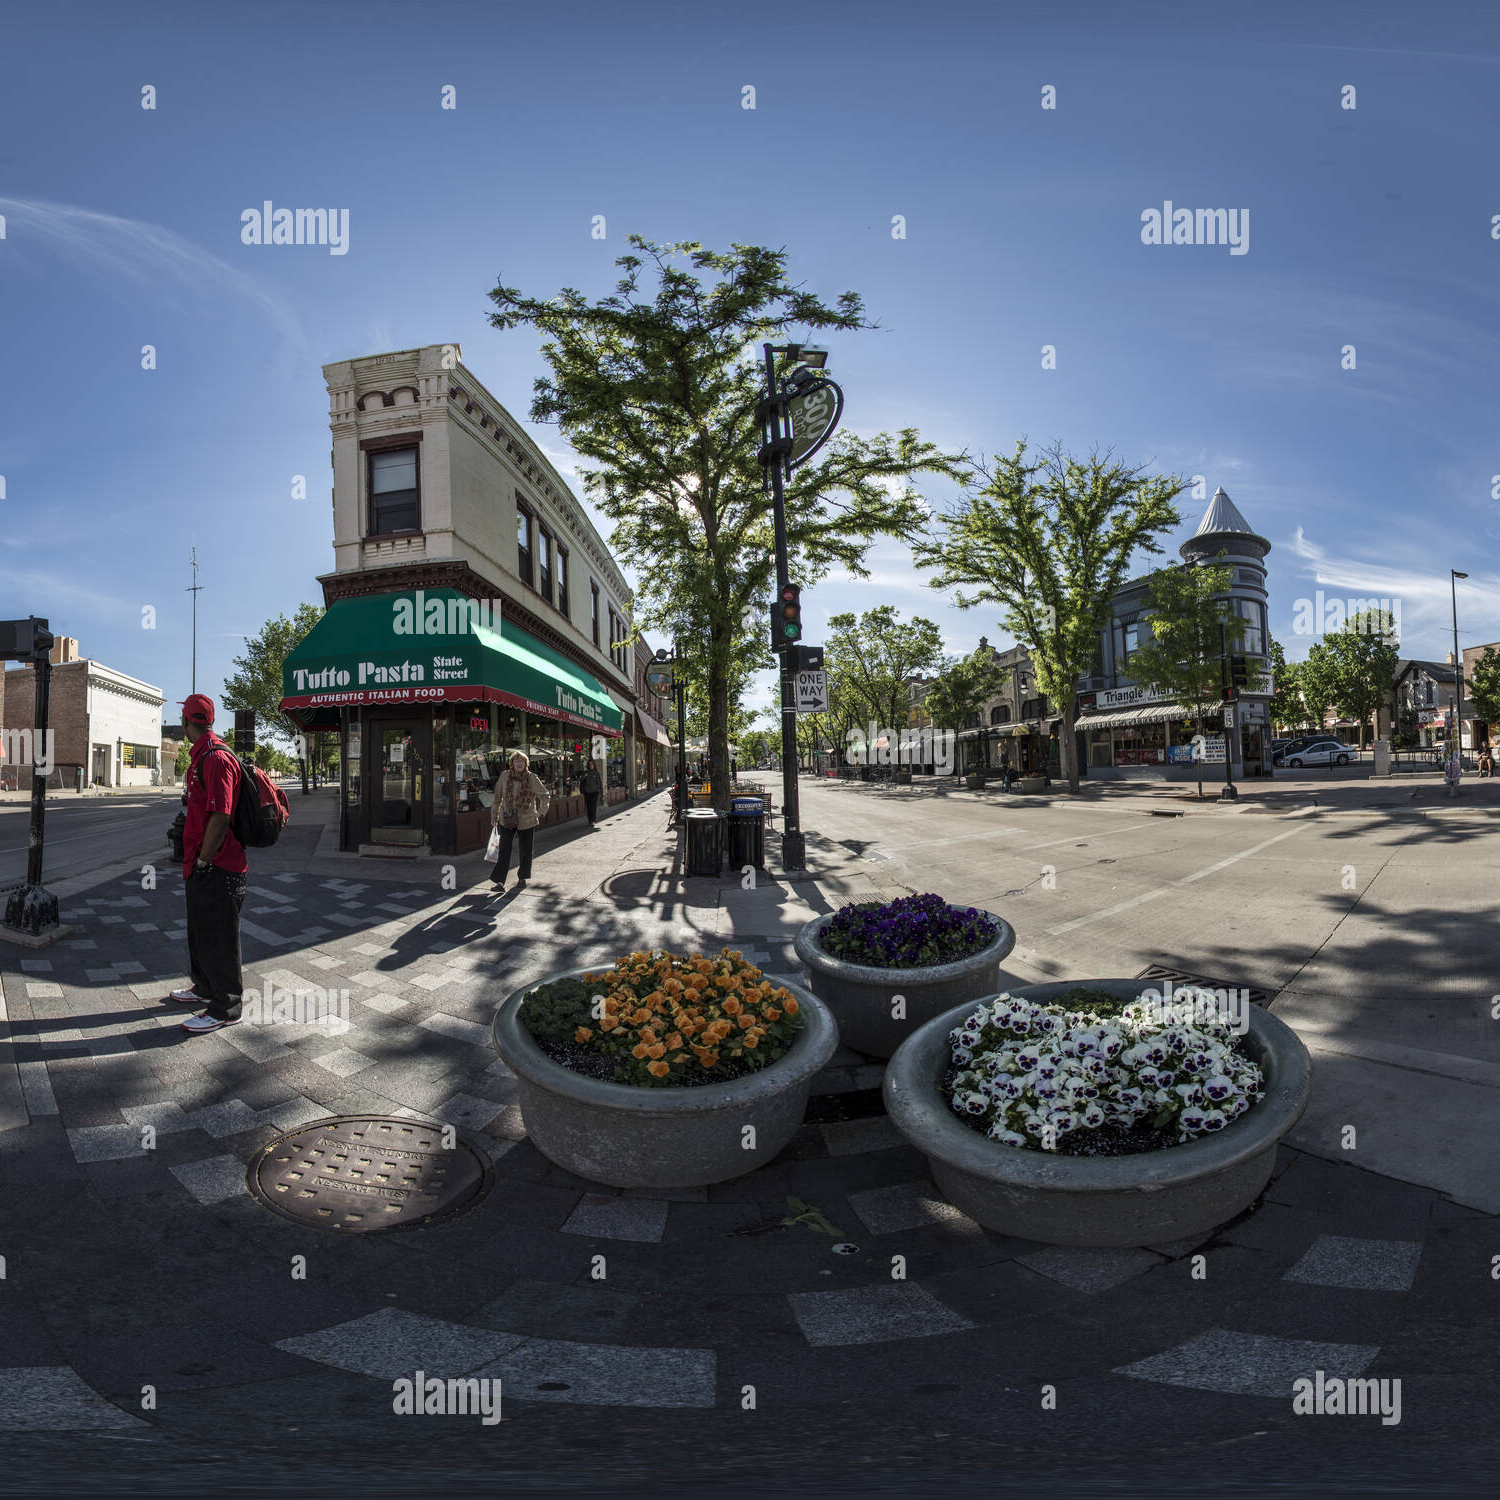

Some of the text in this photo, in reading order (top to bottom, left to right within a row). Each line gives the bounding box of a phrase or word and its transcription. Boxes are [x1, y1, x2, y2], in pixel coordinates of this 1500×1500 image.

[804, 389, 828, 439] 300
[433, 656, 463, 667] State
[293, 659, 424, 690] Tutto Pasta
[433, 667, 468, 680] Street
[800, 674, 823, 684] ONE
[310, 688, 445, 704] AUTHENTIC ITALIAN FOOD
[800, 686, 823, 696] WAY
[1104, 687, 1143, 702] Triangle
[526, 700, 547, 713] FRIENDLY
[548, 707, 560, 716] STAFF
[556, 685, 595, 719] Tutto Pasta
[470, 717, 489, 731] OPEN
